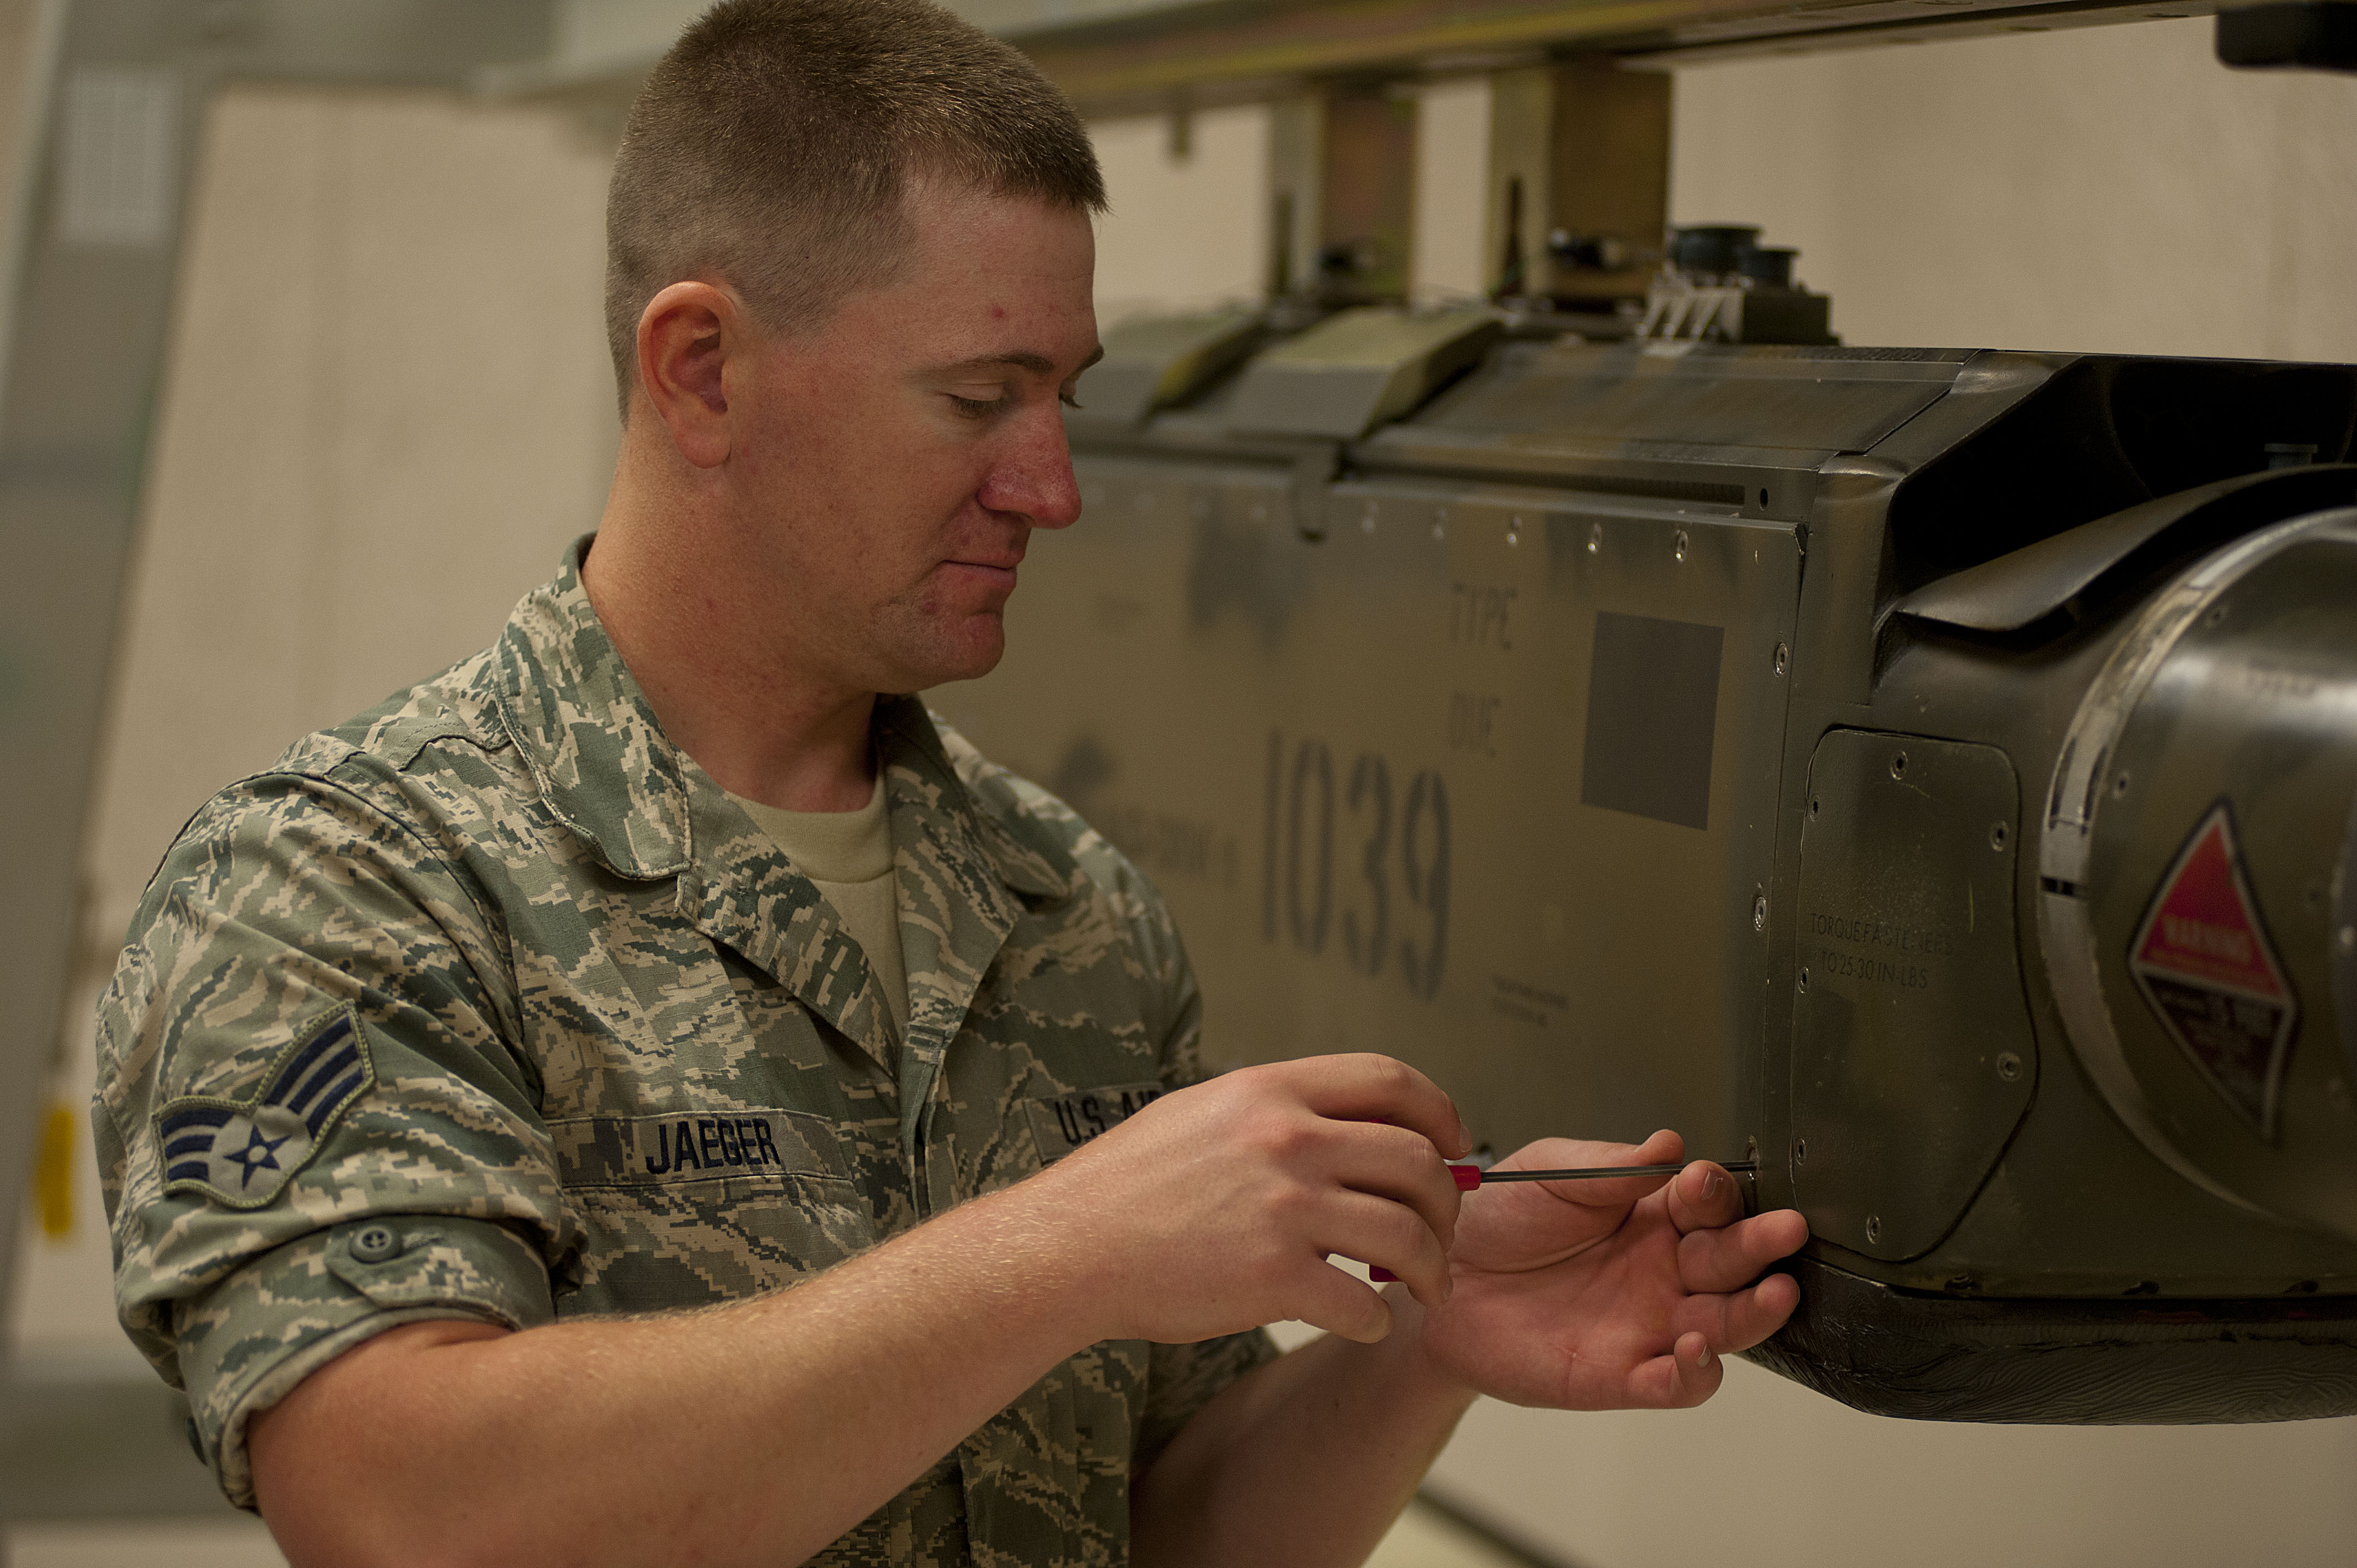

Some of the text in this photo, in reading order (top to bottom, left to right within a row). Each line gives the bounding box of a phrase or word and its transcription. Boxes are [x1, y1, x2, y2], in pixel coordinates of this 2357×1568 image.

[1259, 725, 1452, 1003] 1039
[1811, 912, 1861, 942] TORQUE
[1821, 950, 1837, 972] TO
[645, 1118, 781, 1174] JAEGER
